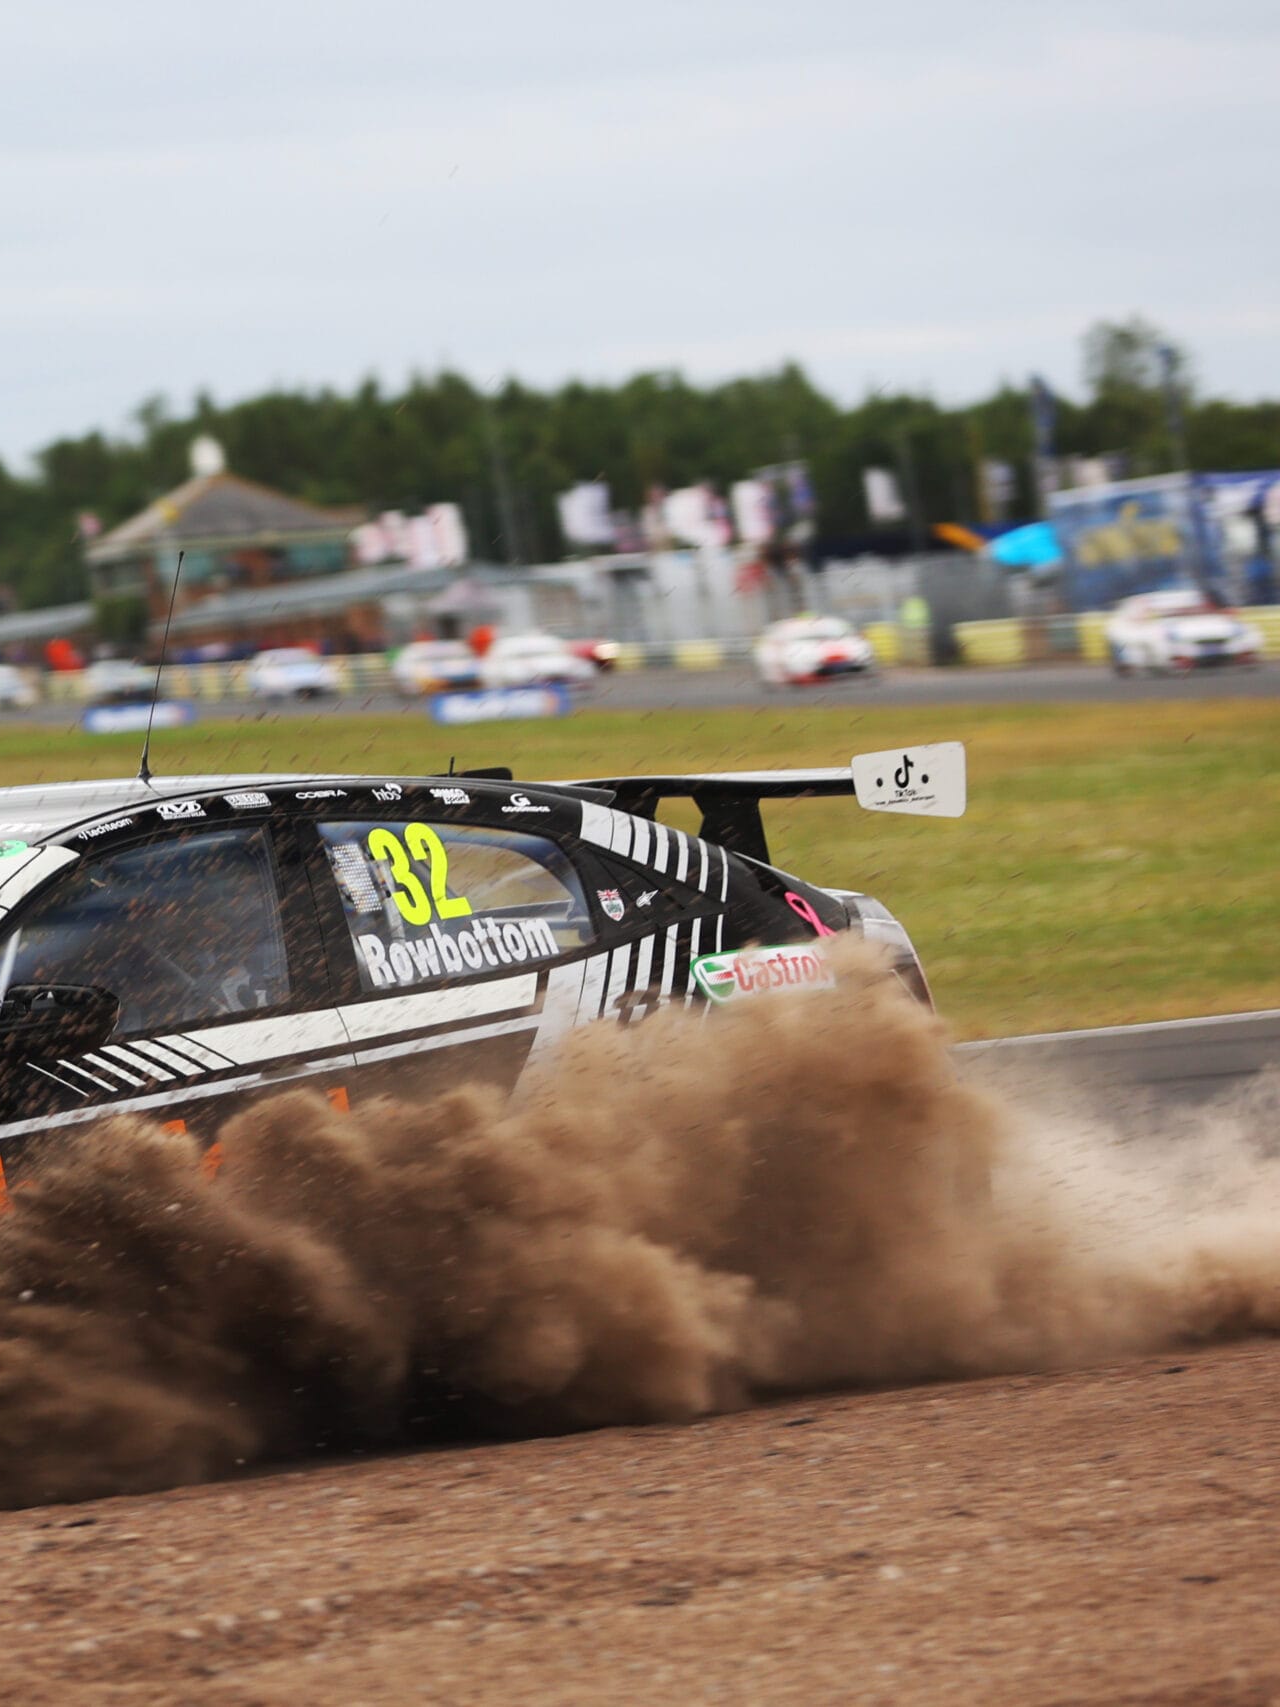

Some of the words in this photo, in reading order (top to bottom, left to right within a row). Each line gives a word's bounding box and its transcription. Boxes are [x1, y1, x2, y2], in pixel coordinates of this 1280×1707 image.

[295, 789, 347, 799] COBRA
[367, 822, 472, 926] 32
[358, 917, 559, 986] Rowbottom
